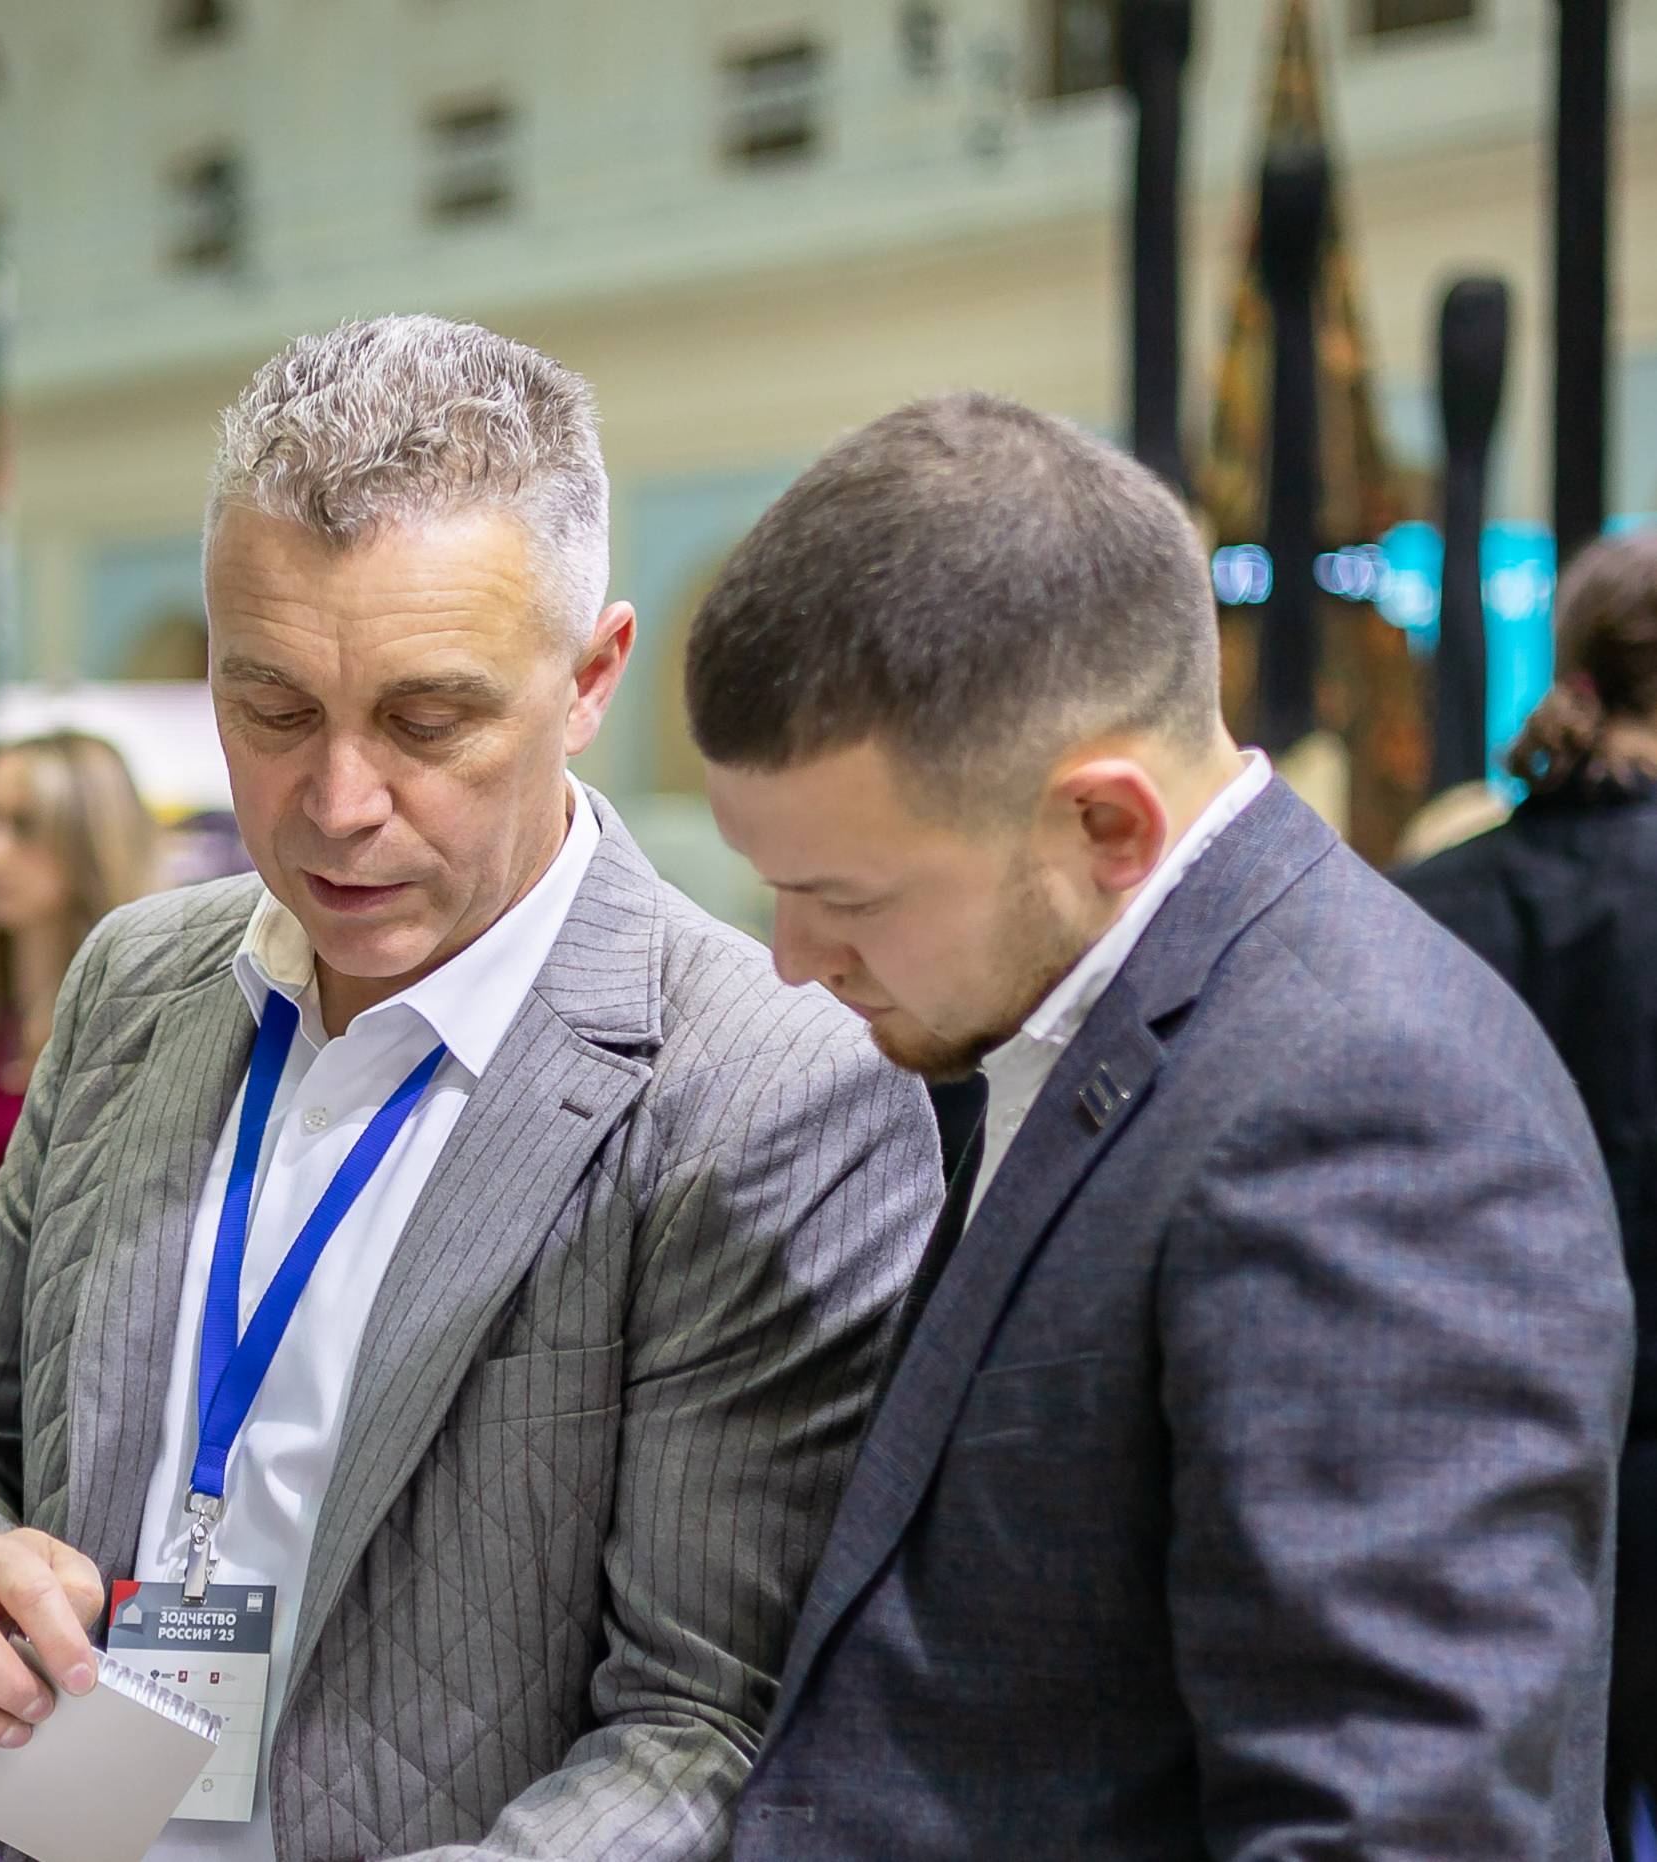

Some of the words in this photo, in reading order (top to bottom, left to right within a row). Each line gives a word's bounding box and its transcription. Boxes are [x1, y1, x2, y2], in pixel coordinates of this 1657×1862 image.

[159, 1611, 237, 1626] ЗОДЧЕСТВО
[158, 1627, 211, 1641] РОССИЯ
[213, 1629, 236, 1642] '25
